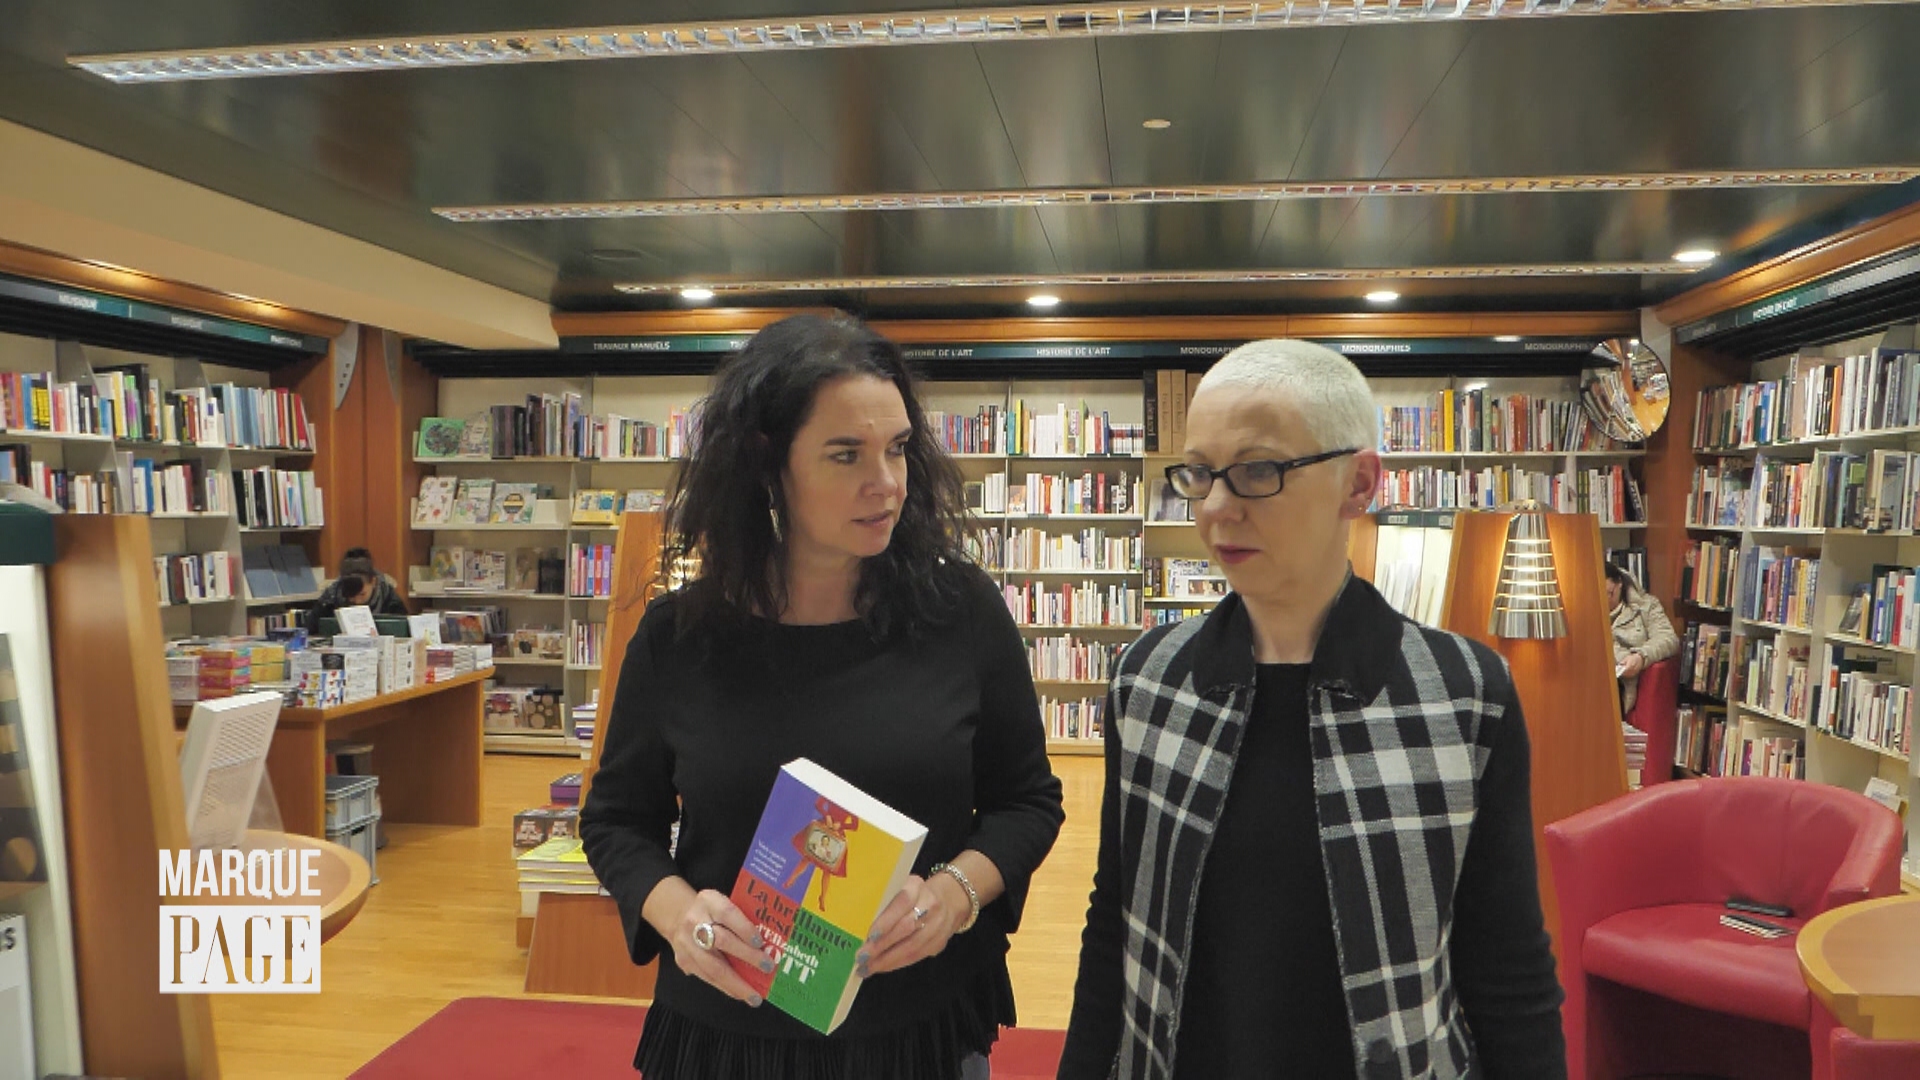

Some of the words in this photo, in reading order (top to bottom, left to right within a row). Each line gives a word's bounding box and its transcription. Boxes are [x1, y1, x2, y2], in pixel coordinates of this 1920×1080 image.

[593, 342, 629, 351] TRAVAUX
[630, 341, 670, 351] MANUELS
[1036, 347, 1074, 357] HISTOIRE
[1076, 346, 1087, 356] DE
[1088, 346, 1111, 355] L'ART
[1341, 344, 1411, 353] MONOGRAPHIES
[747, 879, 767, 904] La
[773, 895, 852, 950] brillante
[763, 941, 816, 984] OTT
